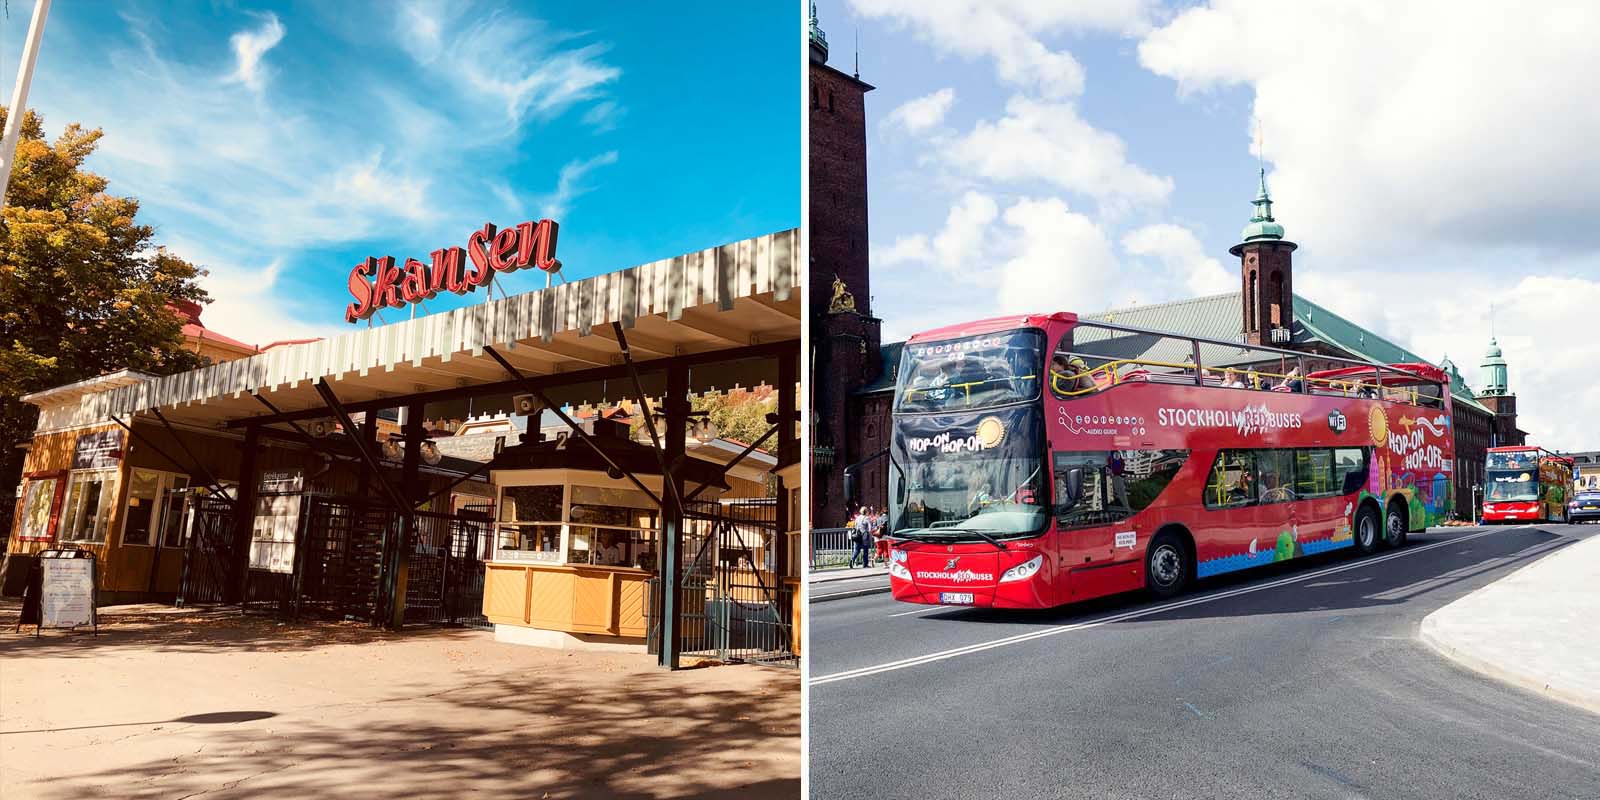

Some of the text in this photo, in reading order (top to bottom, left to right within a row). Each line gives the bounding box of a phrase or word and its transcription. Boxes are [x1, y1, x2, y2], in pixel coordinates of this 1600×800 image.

[345, 218, 562, 324] Skansen
[1158, 408, 1243, 427] STOCKHOLM
[1269, 413, 1302, 428] BUSES
[496, 437, 503, 454] 1
[556, 432, 568, 450] 2
[910, 432, 950, 451] HOP-ON
[1387, 427, 1425, 456] HOP-ON
[1405, 444, 1443, 470] HOP-OFF
[916, 571, 953, 580] STOCKHOLM
[972, 573, 994, 581] BUSES
